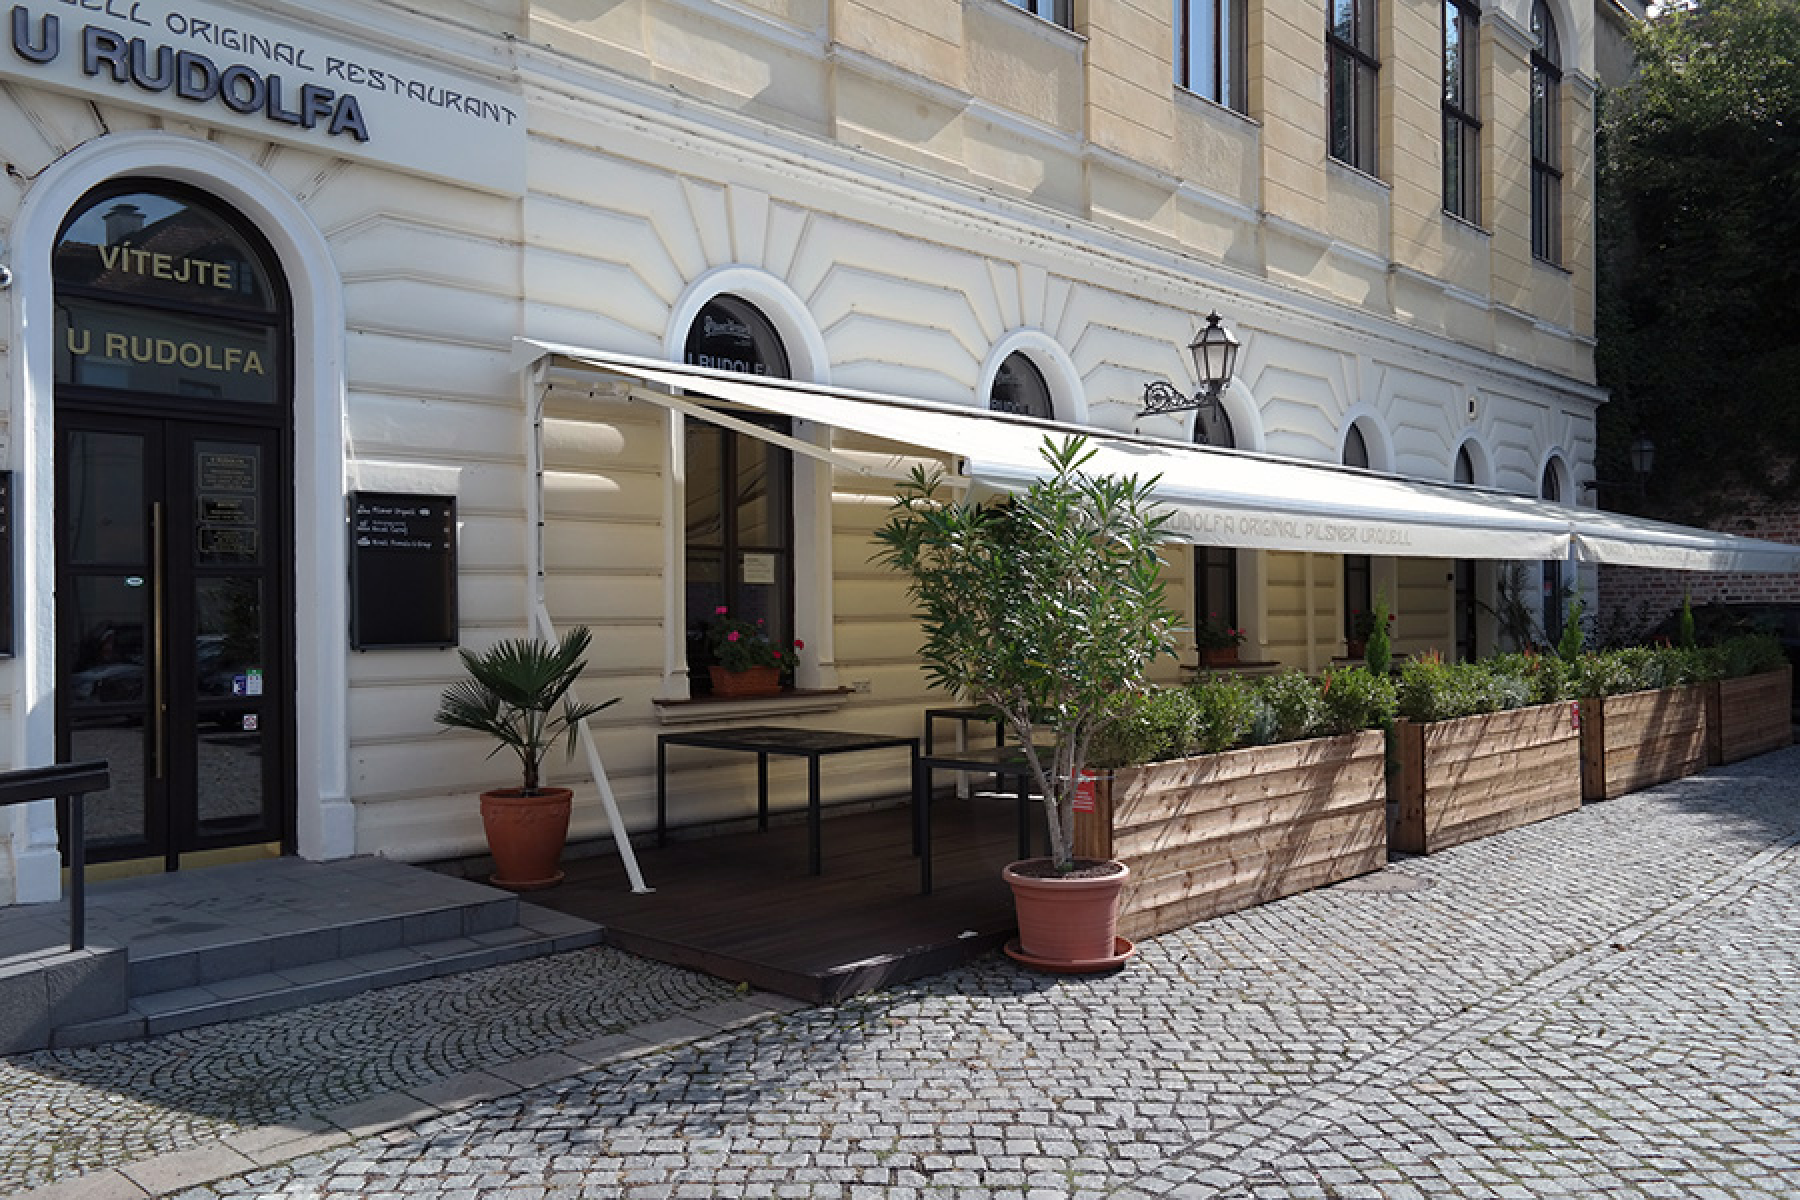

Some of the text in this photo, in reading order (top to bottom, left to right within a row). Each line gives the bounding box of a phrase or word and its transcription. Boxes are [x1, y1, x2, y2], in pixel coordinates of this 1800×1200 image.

[12, 5, 370, 143] U RUDOLFA
[165, 12, 315, 71] ORIGINAL
[325, 56, 518, 126] RESTAURANT
[100, 241, 233, 289] VÍTEJTE
[67, 327, 265, 375] U RUDOLFA
[1239, 517, 1301, 539] ORIGINAL
[1305, 523, 1358, 542] PILSNER
[1360, 528, 1413, 547] URQUELL
